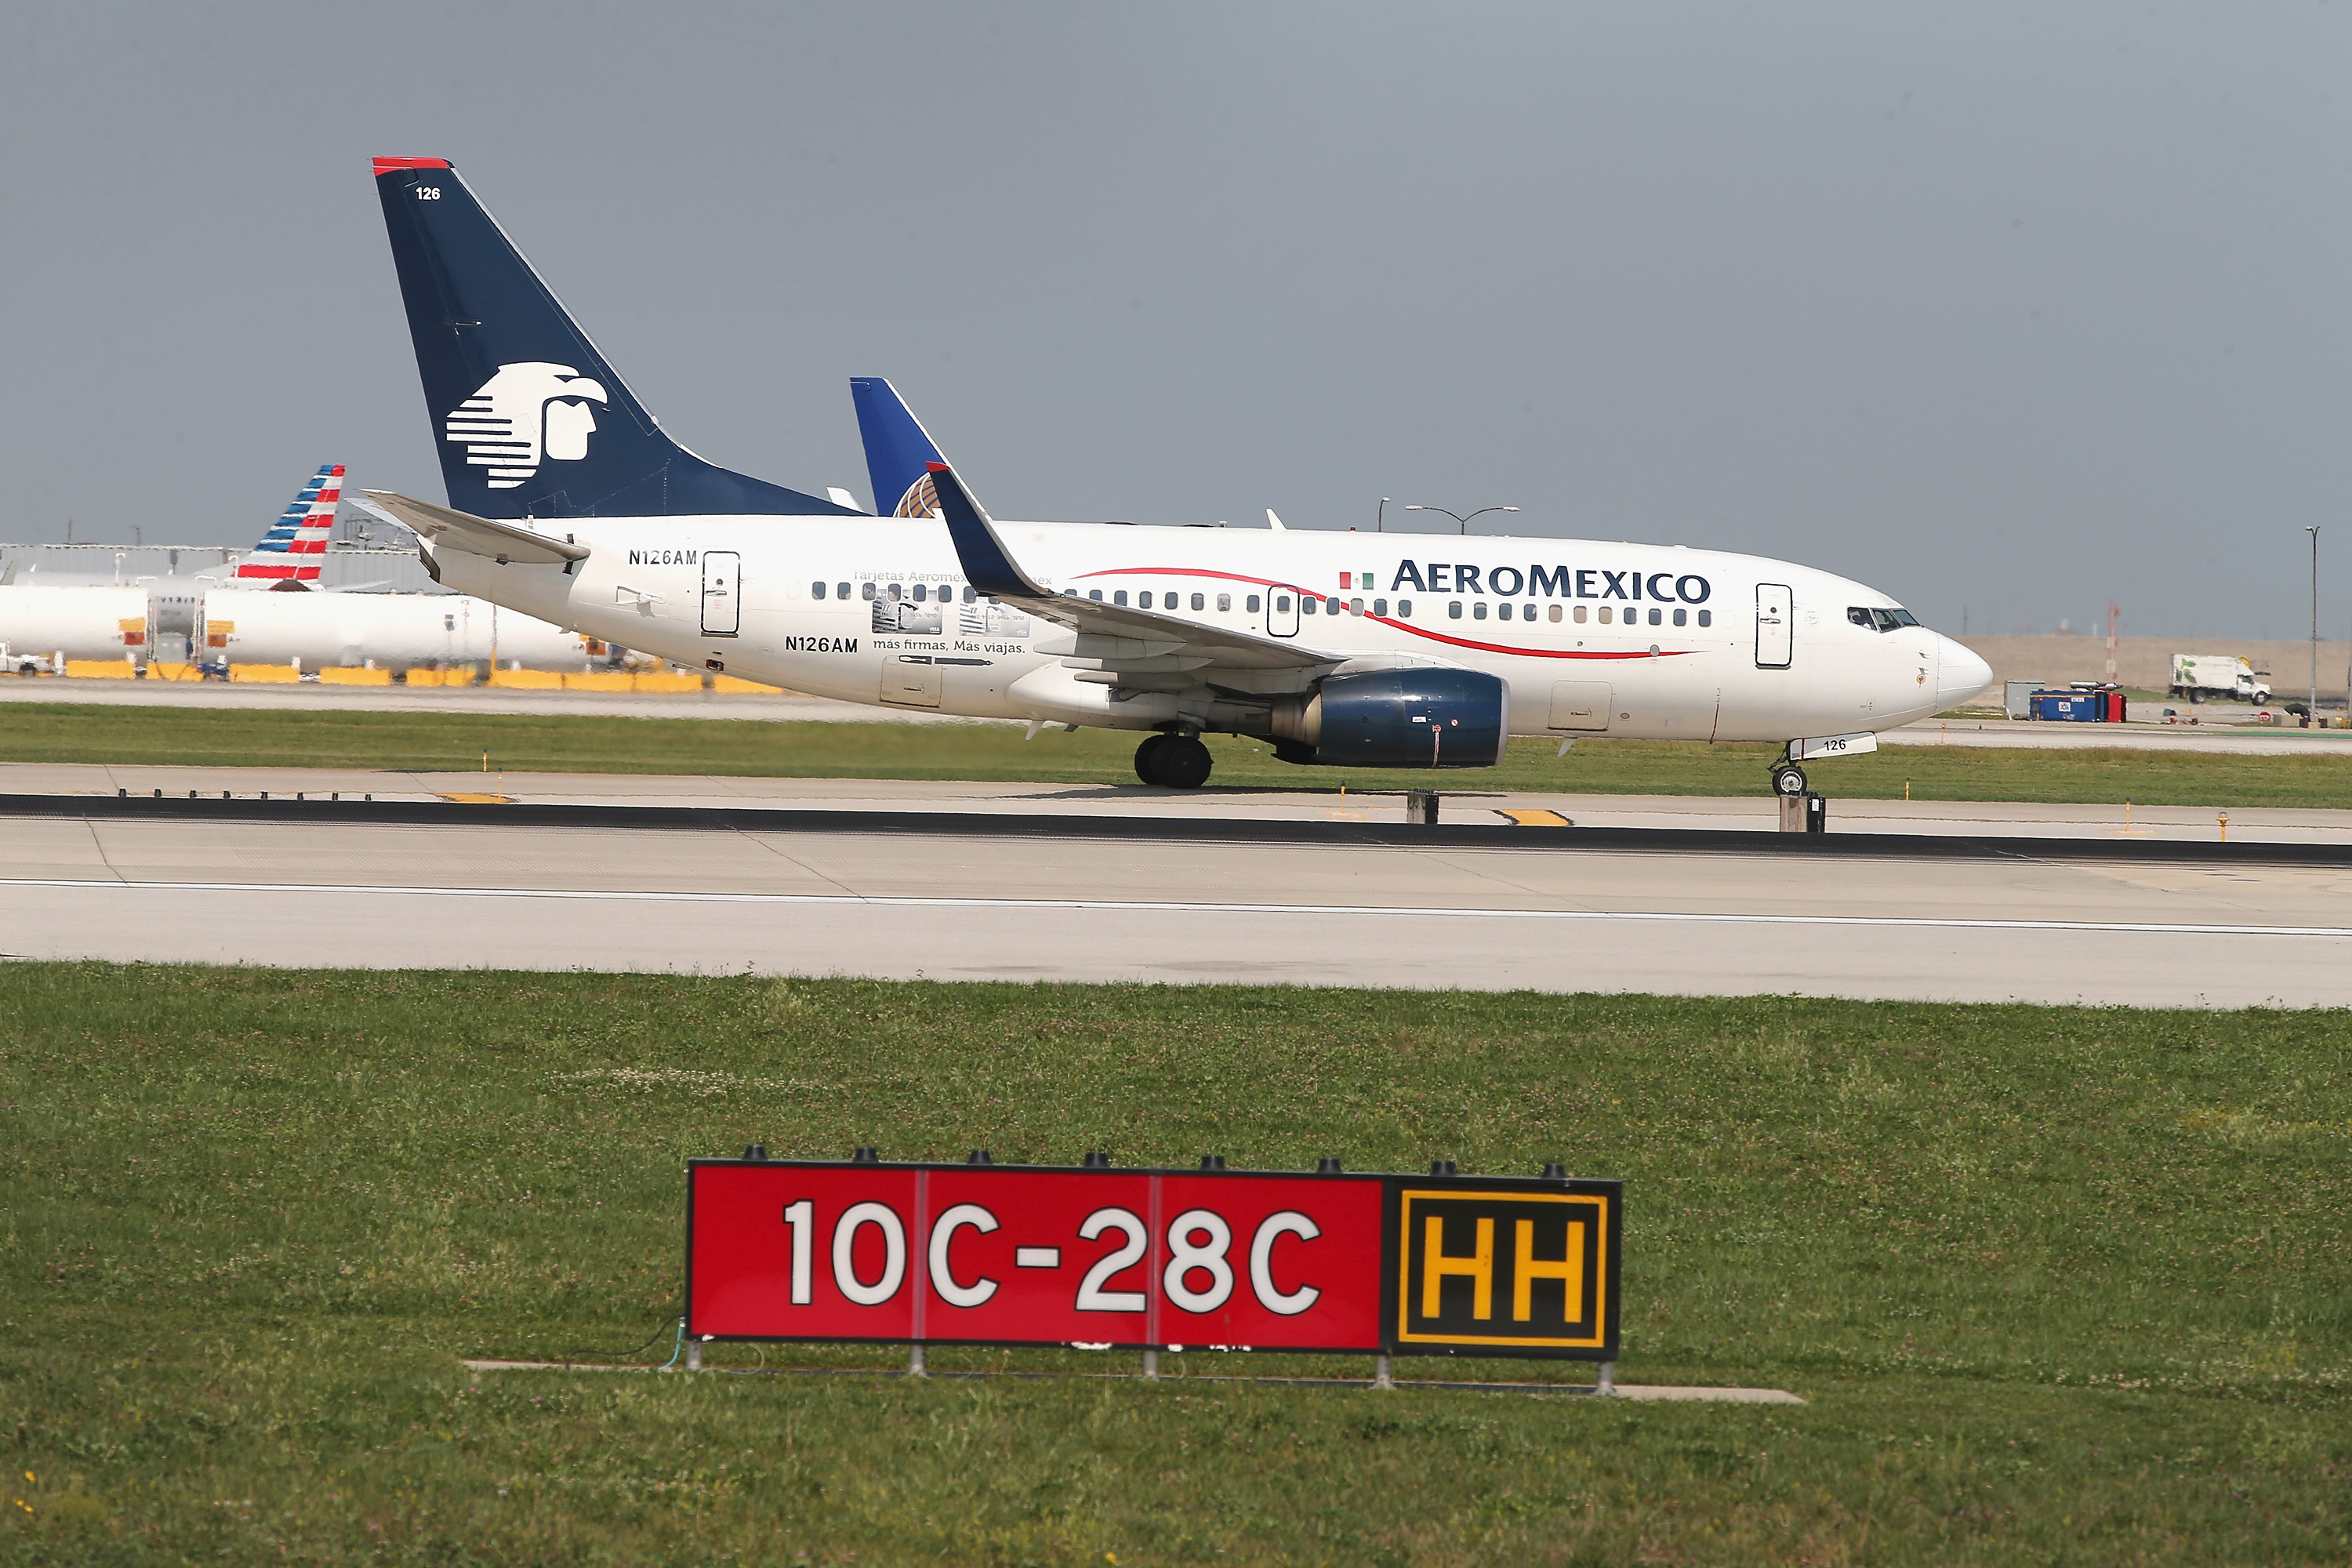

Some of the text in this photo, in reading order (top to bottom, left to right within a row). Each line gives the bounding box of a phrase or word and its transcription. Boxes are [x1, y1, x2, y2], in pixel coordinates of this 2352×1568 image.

[416, 187, 441, 200] 126
[629, 550, 697, 564] N126AM
[853, 570, 904, 582] Tarjetas
[908, 571, 968, 583] Aeroméx
[1391, 559, 1711, 604] AEROMEXICO
[786, 636, 858, 654] N126AM
[873, 639, 1025, 654] más firmas, Más viajas.
[1824, 739, 1846, 751] 126
[784, 1200, 1584, 1324] 10C-28C HH
